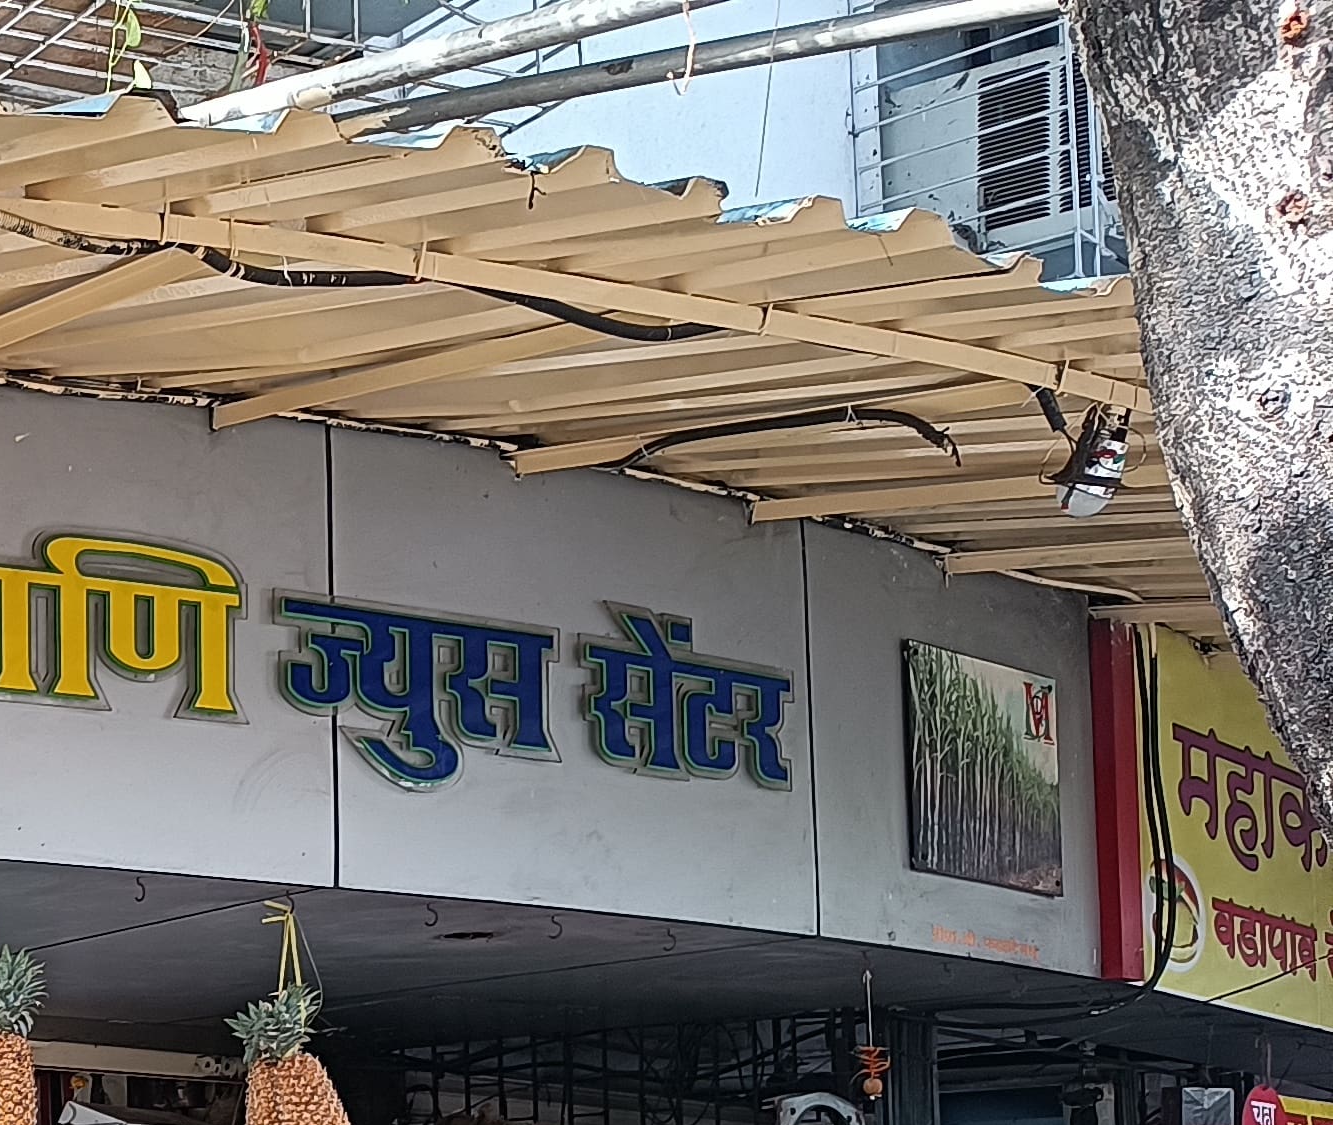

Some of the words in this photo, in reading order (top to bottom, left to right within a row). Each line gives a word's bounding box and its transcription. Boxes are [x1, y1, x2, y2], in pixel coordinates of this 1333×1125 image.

[278, 598, 554, 787] ज्युस
[582, 609, 791, 783] सेंटर
[1212, 897, 1317, 982] वडापाव
